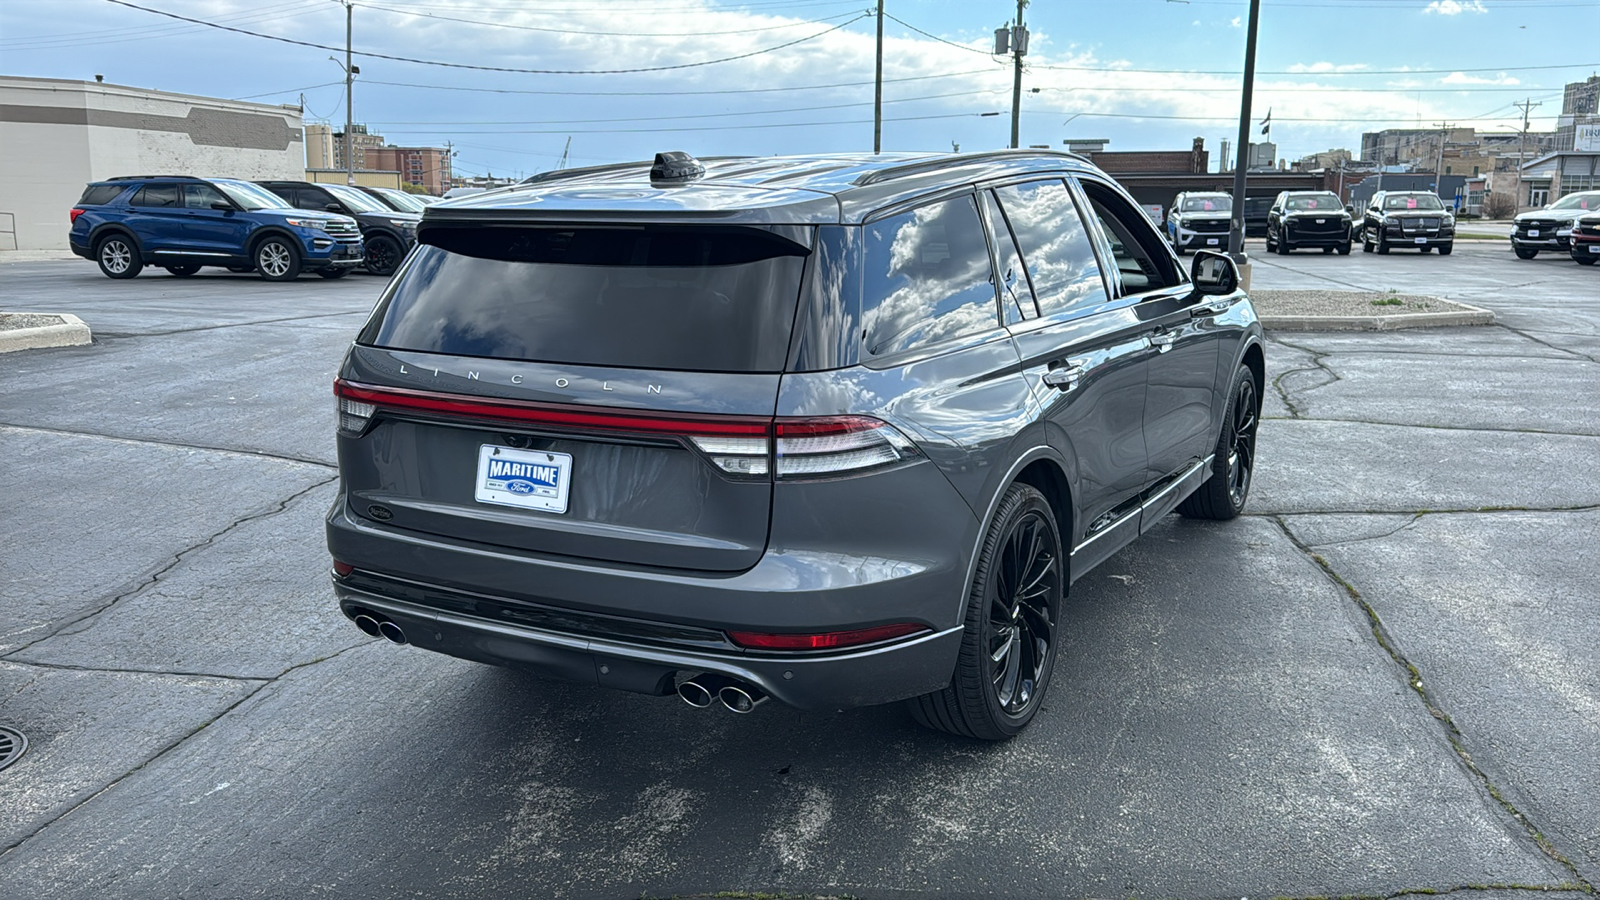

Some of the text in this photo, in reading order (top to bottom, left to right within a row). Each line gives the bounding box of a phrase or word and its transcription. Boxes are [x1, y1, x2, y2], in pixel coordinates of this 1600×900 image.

[400, 365, 661, 394] LINCOLN
[489, 460, 557, 486] MARITIME
[510, 482, 531, 493] Ford
